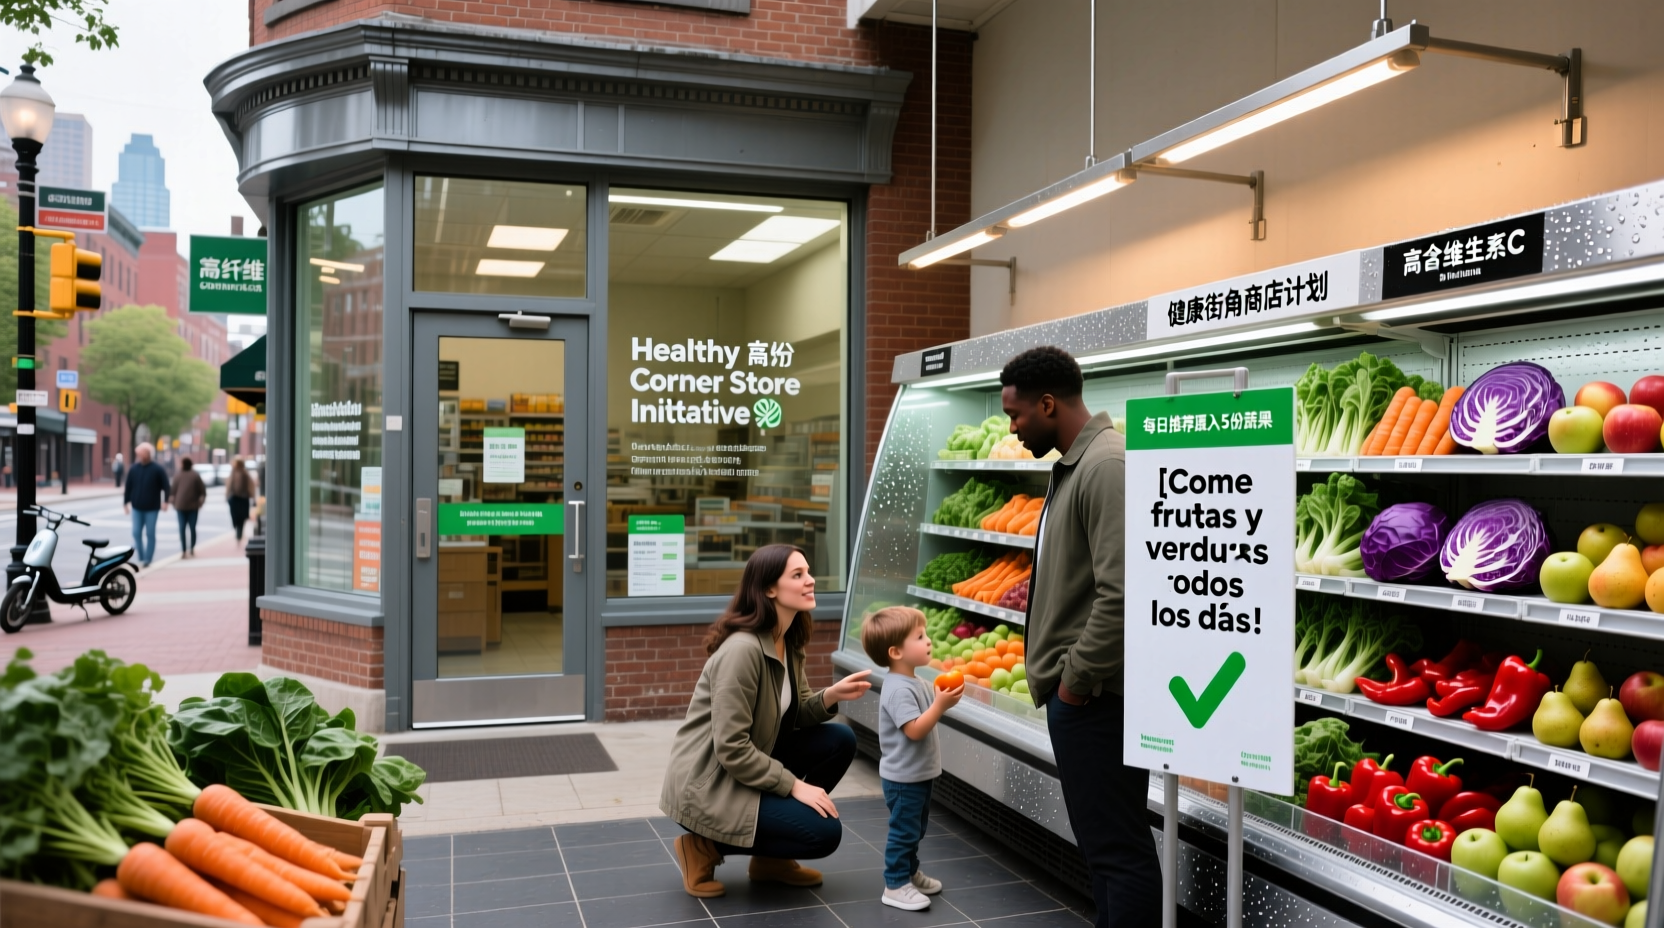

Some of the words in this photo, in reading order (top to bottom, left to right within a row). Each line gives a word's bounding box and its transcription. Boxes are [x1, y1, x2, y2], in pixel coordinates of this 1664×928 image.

[1167, 270, 1329, 328] 健康街角商店计划
[631, 336, 741, 370] Healthy
[629, 366, 725, 395] Corner
[729, 370, 801, 396] Store
[1150, 500, 1237, 529] frutas
[1244, 508, 1263, 536] y
[1167, 569, 1244, 598] odos
[1151, 600, 1191, 628] los
